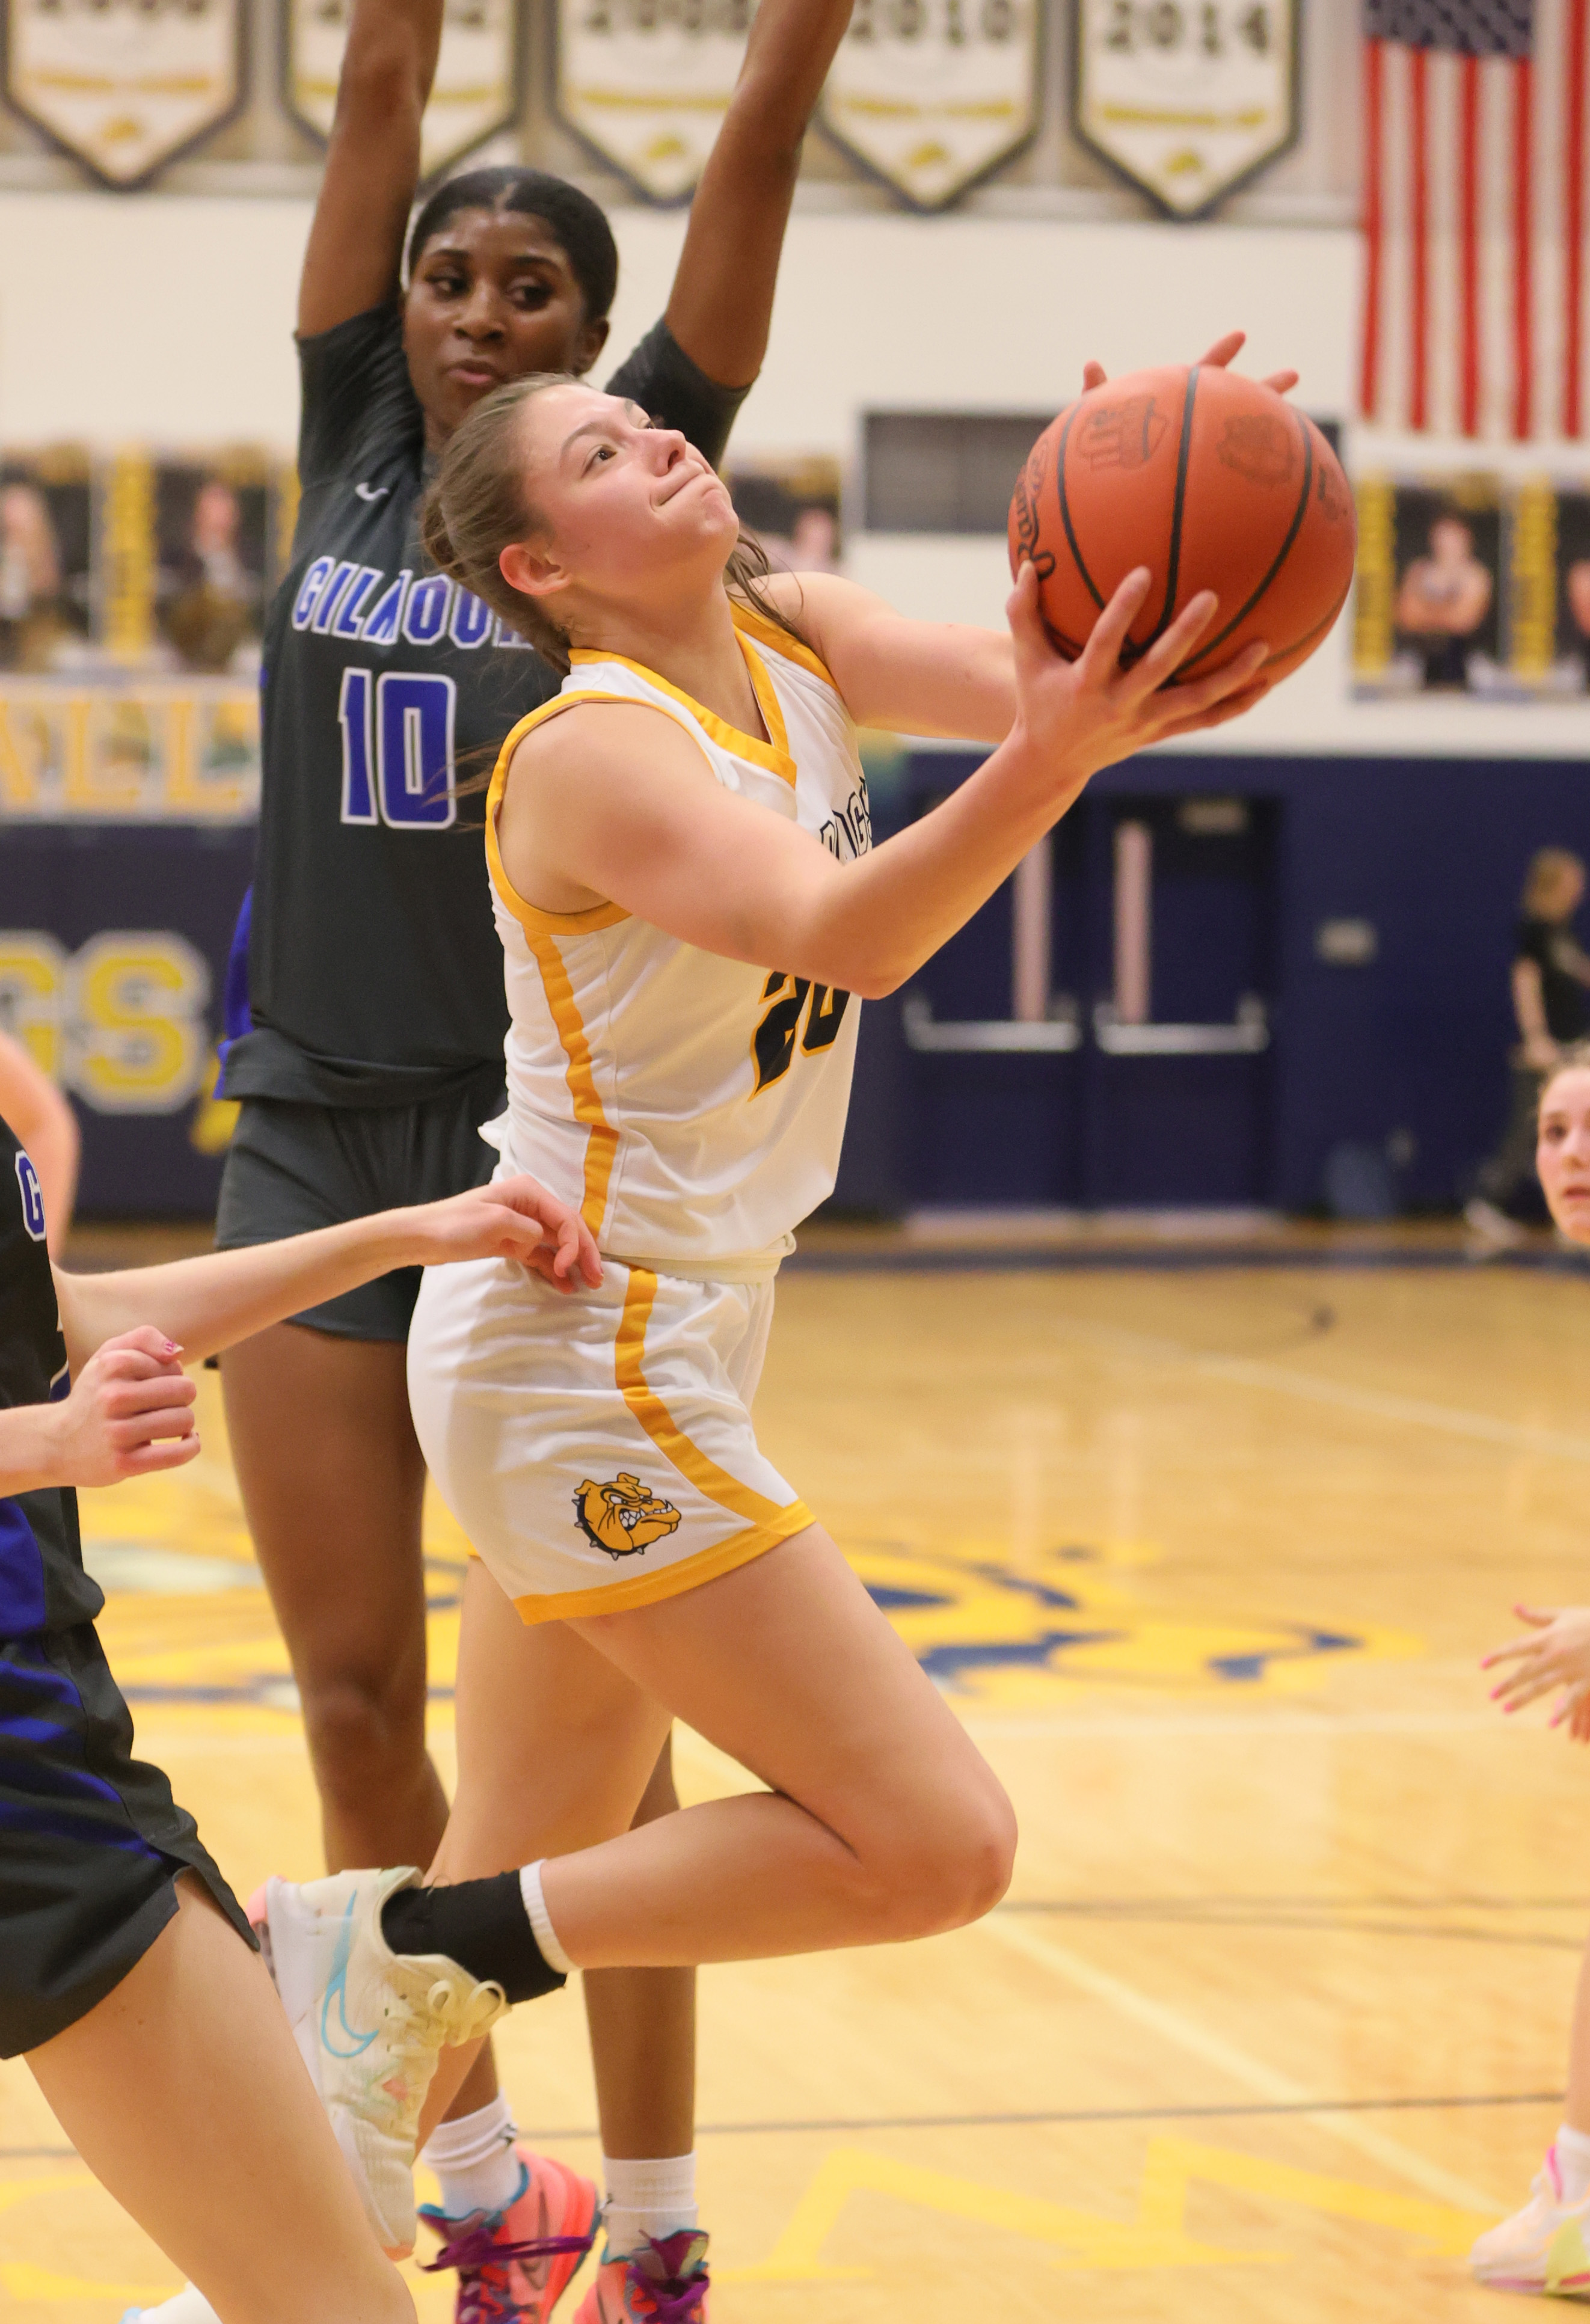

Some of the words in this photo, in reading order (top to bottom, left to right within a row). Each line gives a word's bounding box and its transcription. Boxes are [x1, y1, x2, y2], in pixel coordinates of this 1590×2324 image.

[1104, 0, 1270, 55] 2014
[292, 555, 534, 649] GILMOU
[338, 667, 457, 830] 10
